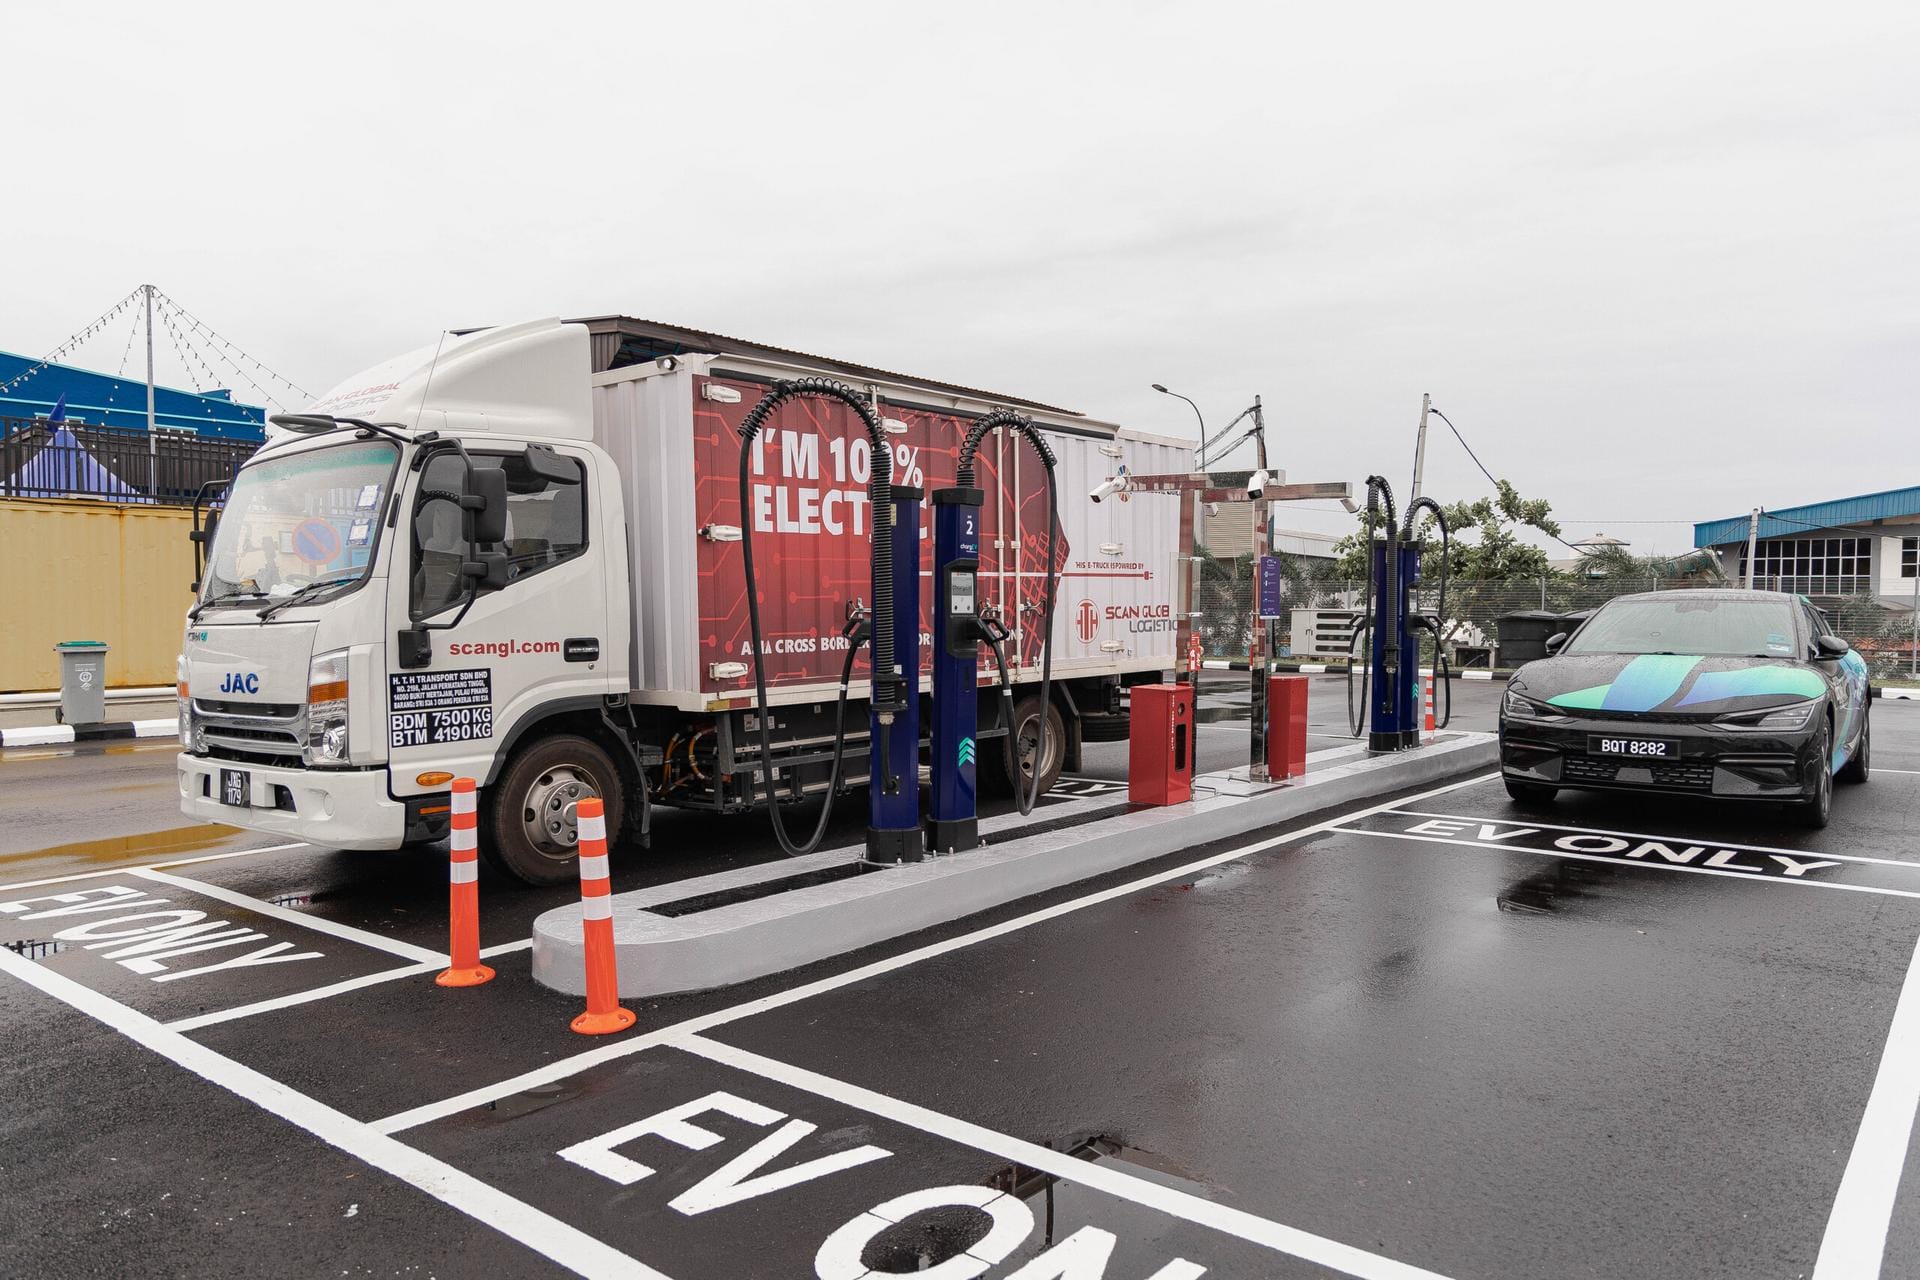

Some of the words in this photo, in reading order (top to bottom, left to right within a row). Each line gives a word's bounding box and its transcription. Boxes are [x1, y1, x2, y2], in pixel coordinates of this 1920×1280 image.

[752, 428, 819, 480] I'M
[966, 520, 973, 535] 2
[1105, 605, 1139, 619] SCAN
[450, 639, 560, 658] scangl.com
[775, 638, 816, 654] CROSS
[220, 673, 259, 694] JAC
[409, 676, 415, 684] H
[416, 673, 458, 683] TRANSPORT
[460, 672, 473, 680] SDN
[410, 692, 425, 700] BUKIT
[455, 689, 470, 697] PULAU
[471, 687, 488, 695] PINANG
[392, 713, 427, 731] BDM
[432, 710, 470, 727] 7500
[473, 708, 491, 723] KG
[392, 729, 427, 746] BTM
[434, 725, 471, 742] 4190
[473, 723, 491, 738] KG
[1602, 739, 1627, 753] BQT
[1630, 741, 1666, 756] 8282
[228, 771, 241, 788] JXG
[228, 787, 241, 805] 1179
[1403, 819, 1543, 841] EV
[1554, 835, 1843, 876] ONLY
[0, 885, 171, 921] EV
[53, 910, 325, 982] ONLY
[555, 1090, 895, 1217] EV
